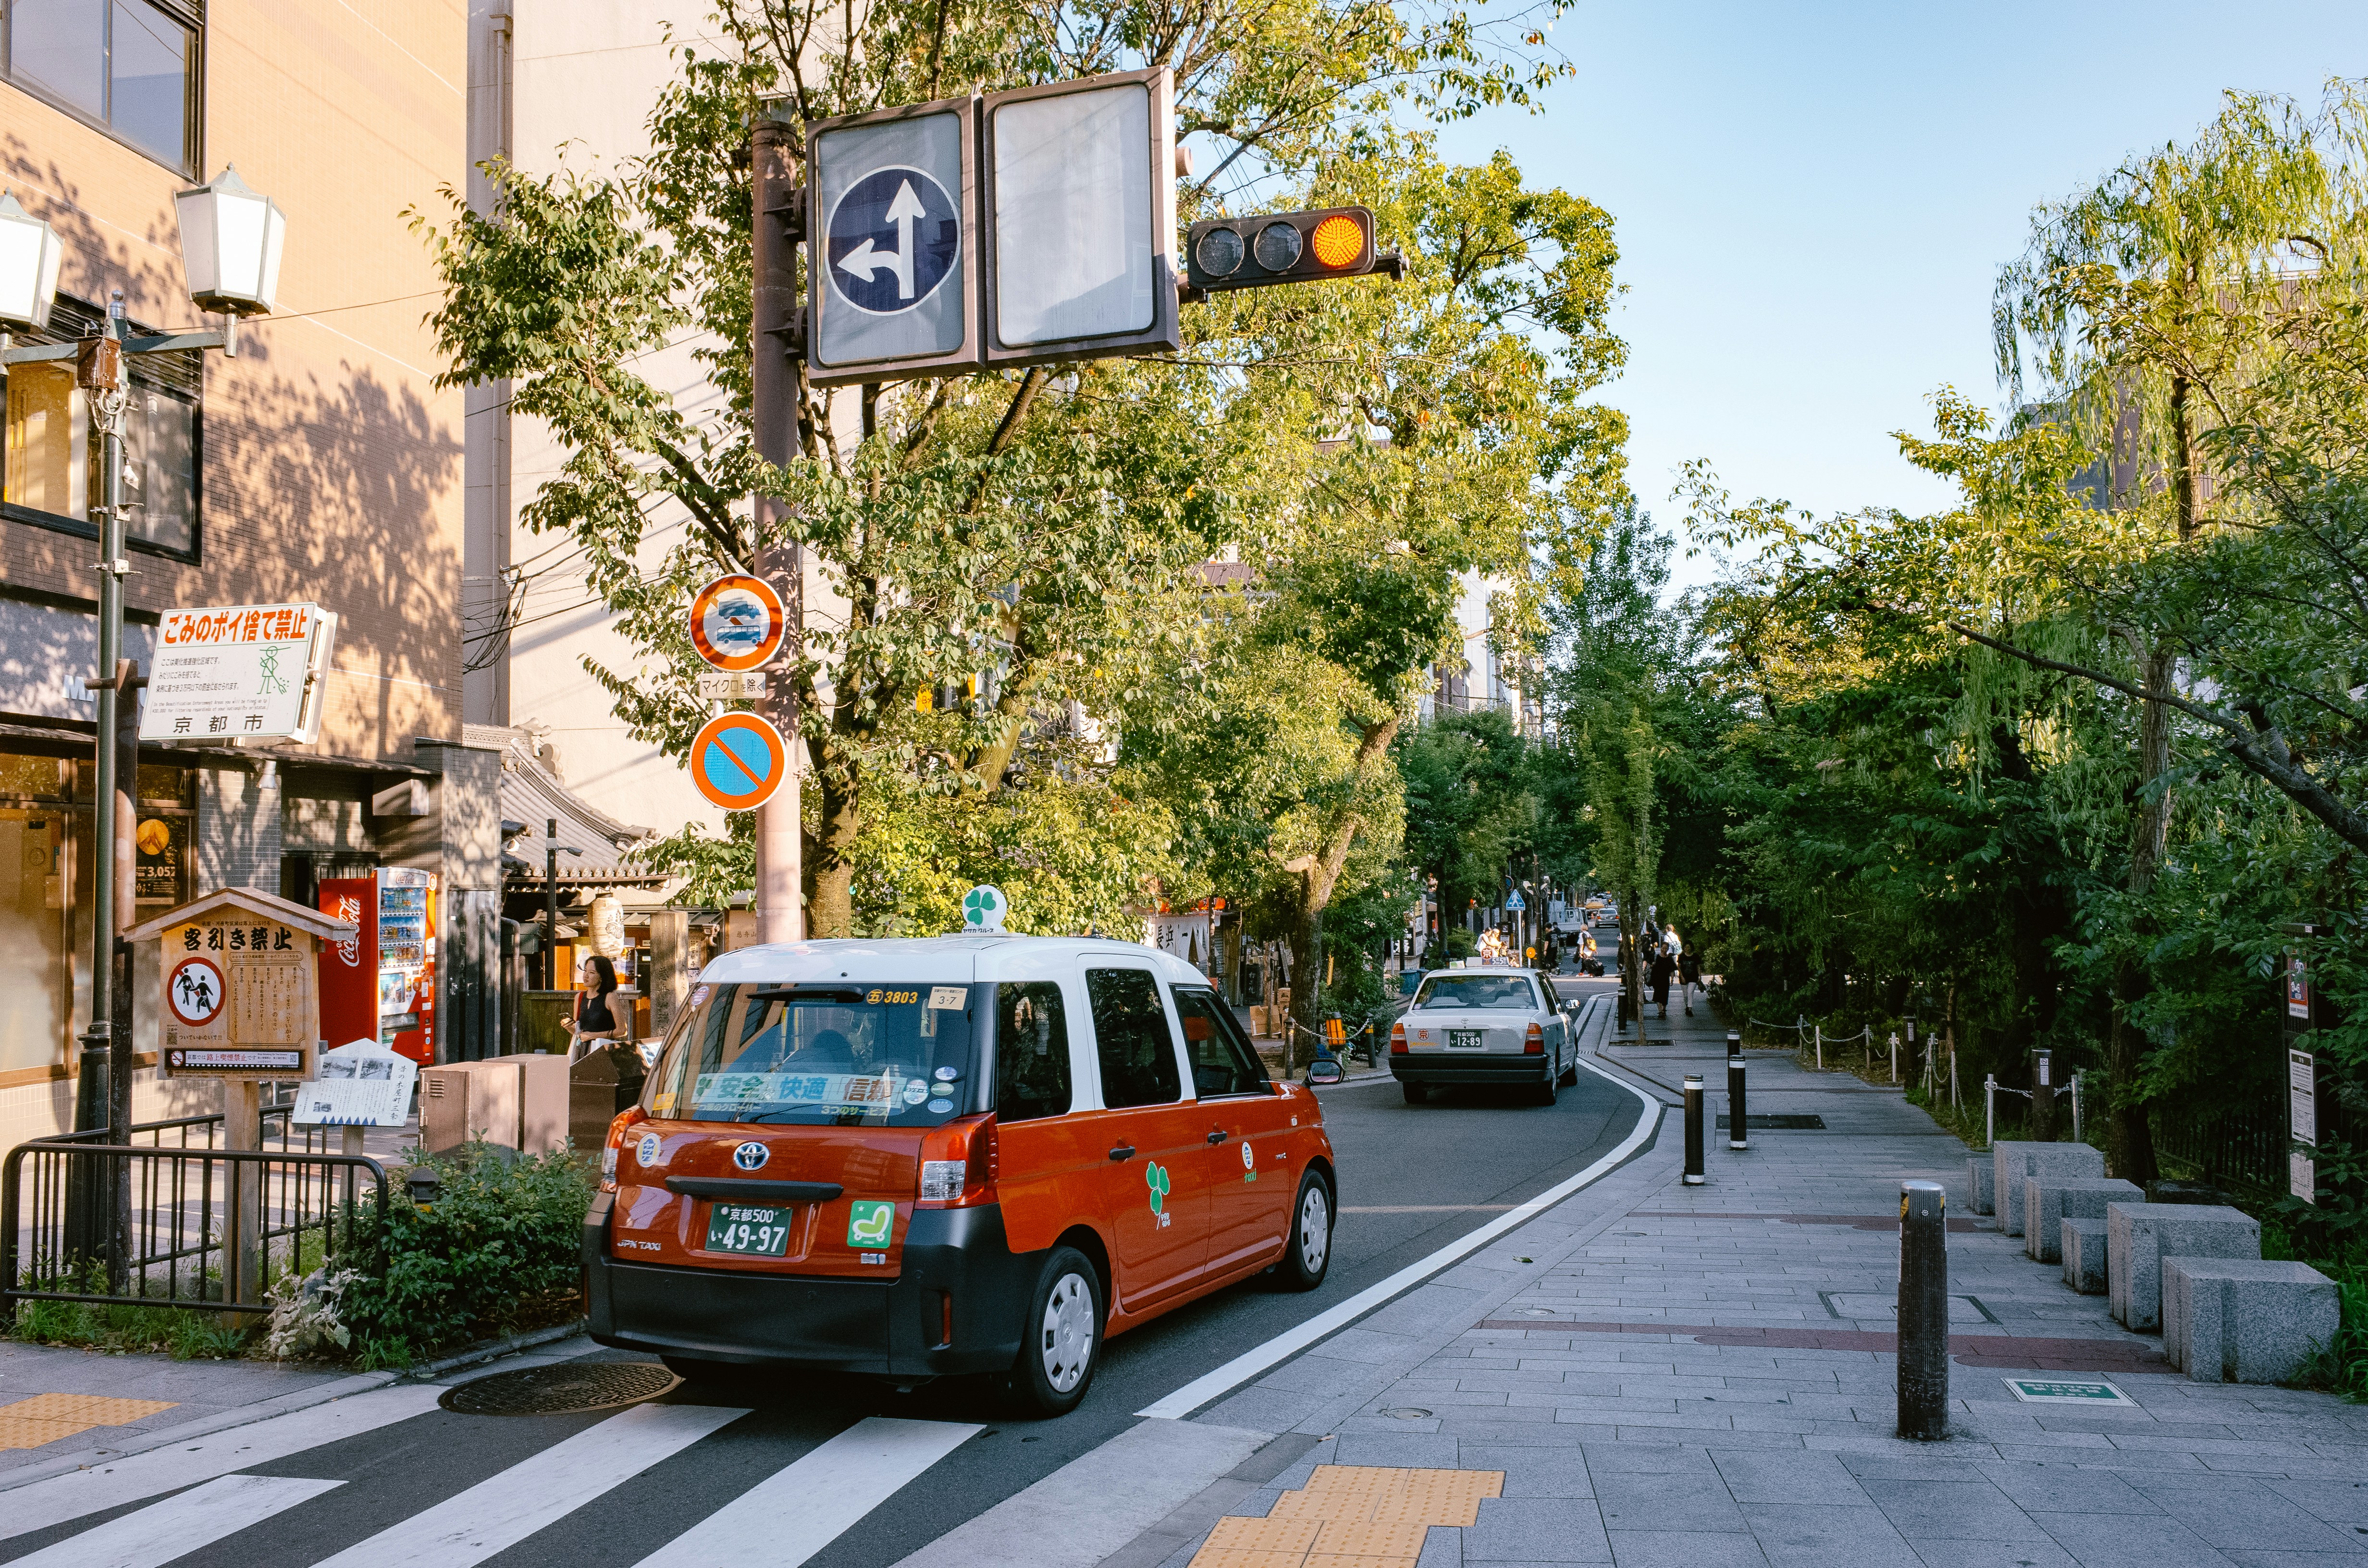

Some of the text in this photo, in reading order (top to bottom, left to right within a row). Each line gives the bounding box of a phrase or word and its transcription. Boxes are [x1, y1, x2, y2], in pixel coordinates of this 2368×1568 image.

[164, 608, 307, 643] ごみのポイ捨て禁止
[702, 679, 763, 692] マイクロを除く
[173, 714, 264, 734] 京都市
[184, 926, 293, 951] 客引き禁止
[868, 991, 918, 1004] 五 3803
[1457, 1037, 1480, 1046] 12-89
[390, 1065, 407, 1120] 昔の木屋町三条
[717, 1076, 765, 1099] 安全
[779, 1076, 829, 1100] 快適
[843, 1078, 897, 1102] 信頼
[821, 1105, 888, 1116] 3つのサービス
[728, 1208, 775, 1223] 京都500
[617, 1239, 662, 1251] JPN TAXI
[711, 1224, 786, 1252] い 49-97
